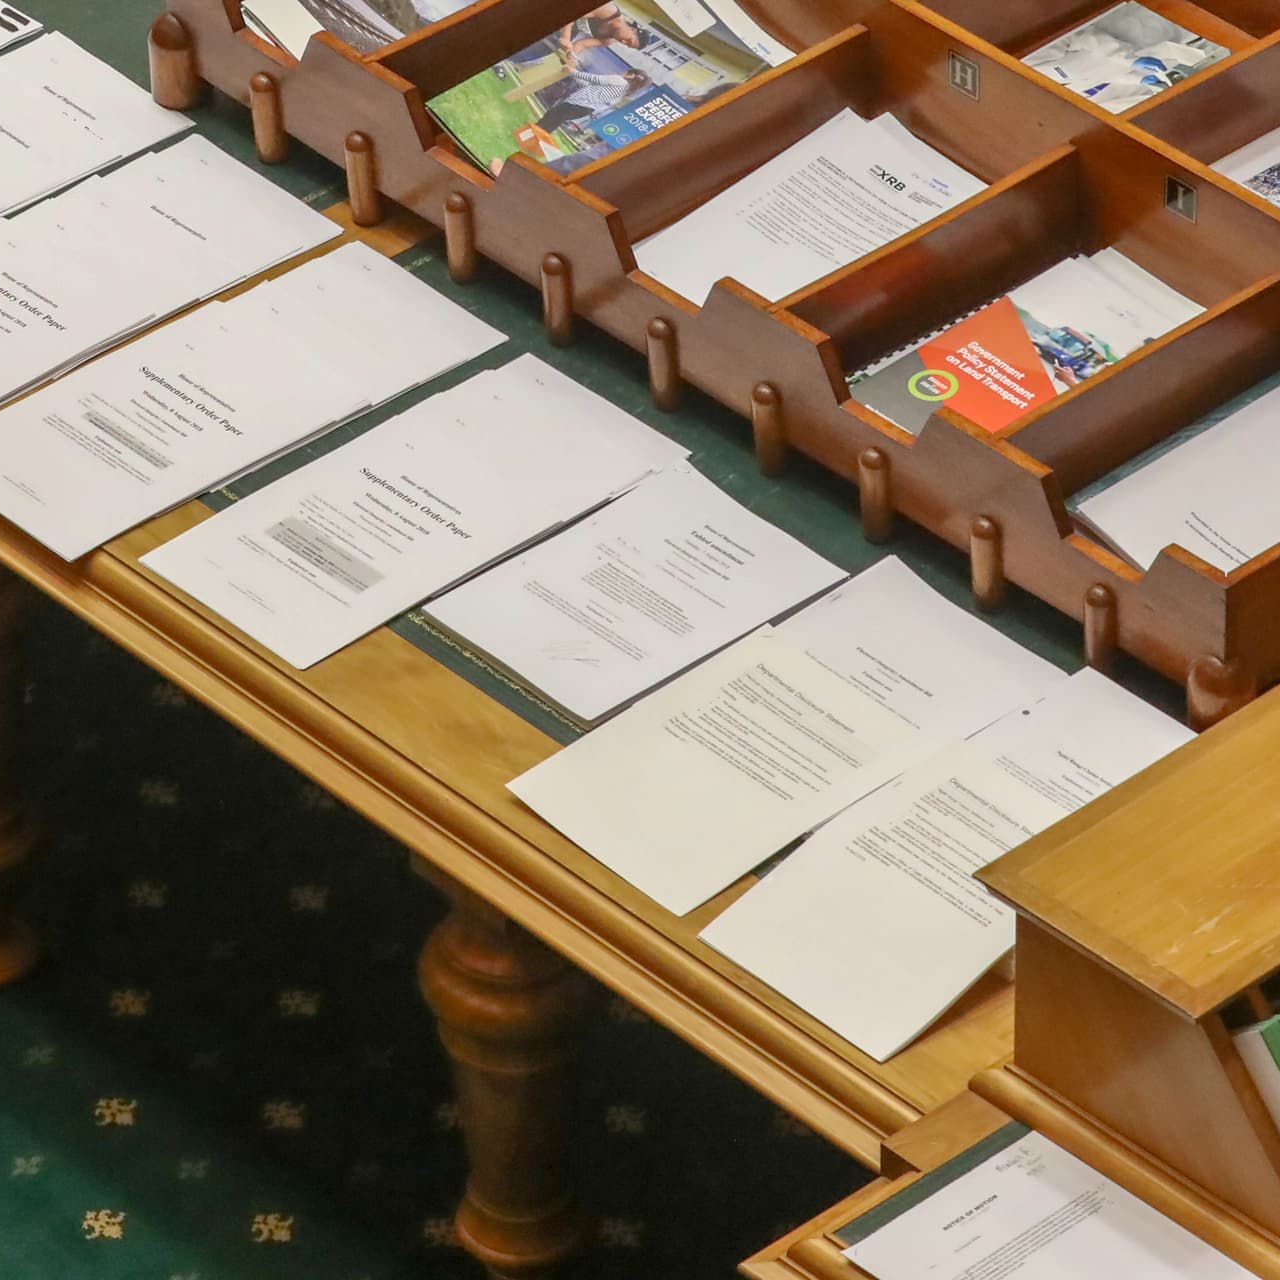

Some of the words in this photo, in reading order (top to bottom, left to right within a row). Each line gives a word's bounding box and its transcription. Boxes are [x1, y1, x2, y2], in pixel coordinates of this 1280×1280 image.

[953, 59, 973, 90] H
[653, 97, 683, 120] STATE
[879, 170, 906, 192] XRB
[1176, 185, 1185, 210] I
[18, 299, 44, 317] Order
[42, 313, 67, 332] Paper
[955, 347, 987, 368] Policy
[984, 364, 1036, 402] Statement
[967, 340, 1026, 381] Government
[138, 366, 195, 405] Supplementary
[195, 402, 221, 421] Order
[219, 418, 245, 437] Paper
[945, 354, 961, 367] on
[958, 362, 983, 381] Land
[981, 377, 1029, 410] Transport
[359, 467, 421, 508] Supplementary
[420, 505, 446, 524] Order
[445, 521, 472, 540] Paper
[756, 662, 795, 695] Departmental
[794, 691, 825, 715] Disclosure
[949, 777, 990, 808] Departmental
[988, 804, 1022, 829] Disclosure
[942, 1214, 966, 1231] NOTICE
[964, 1208, 975, 1218] OF
[973, 1194, 998, 1211] MOTION
